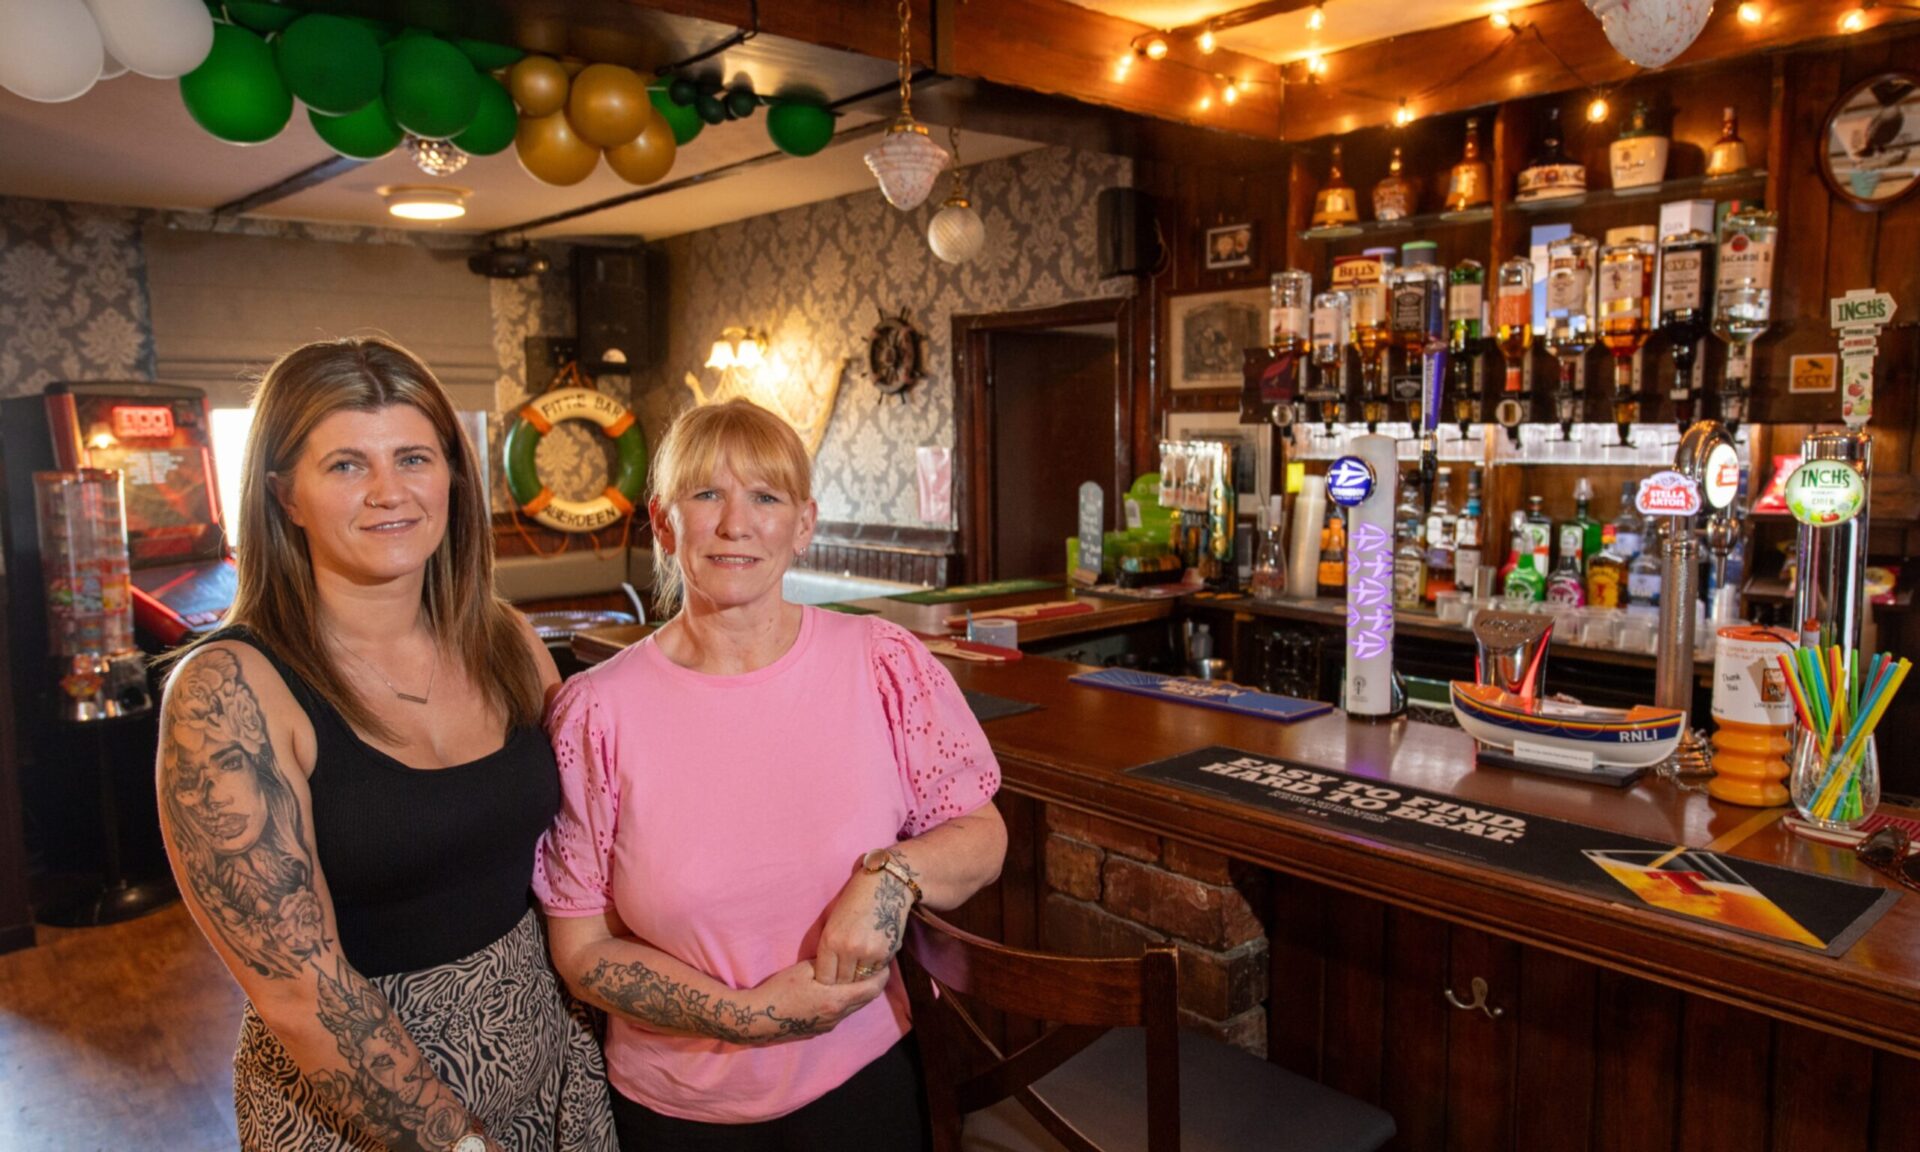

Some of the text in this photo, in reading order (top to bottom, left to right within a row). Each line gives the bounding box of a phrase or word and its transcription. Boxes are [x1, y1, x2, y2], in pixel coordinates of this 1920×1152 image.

[1838, 298, 1886, 322] INCH'S
[1795, 374, 1831, 386] CCTV
[594, 397, 623, 417] BAR
[1800, 468, 1851, 488] INCH'S
[1648, 499, 1686, 508] ARTOIS
[1649, 488, 1686, 500] STELLA
[544, 506, 617, 527] ABERDEEN
[1619, 728, 1658, 743] RNLI
[1198, 762, 1322, 795] HARD
[1323, 789, 1388, 811] TO
[1386, 806, 1526, 844] BEAT.
[1227, 757, 1340, 785] EASY
[1339, 781, 1402, 801] TO
[1402, 796, 1527, 833] FIND.
